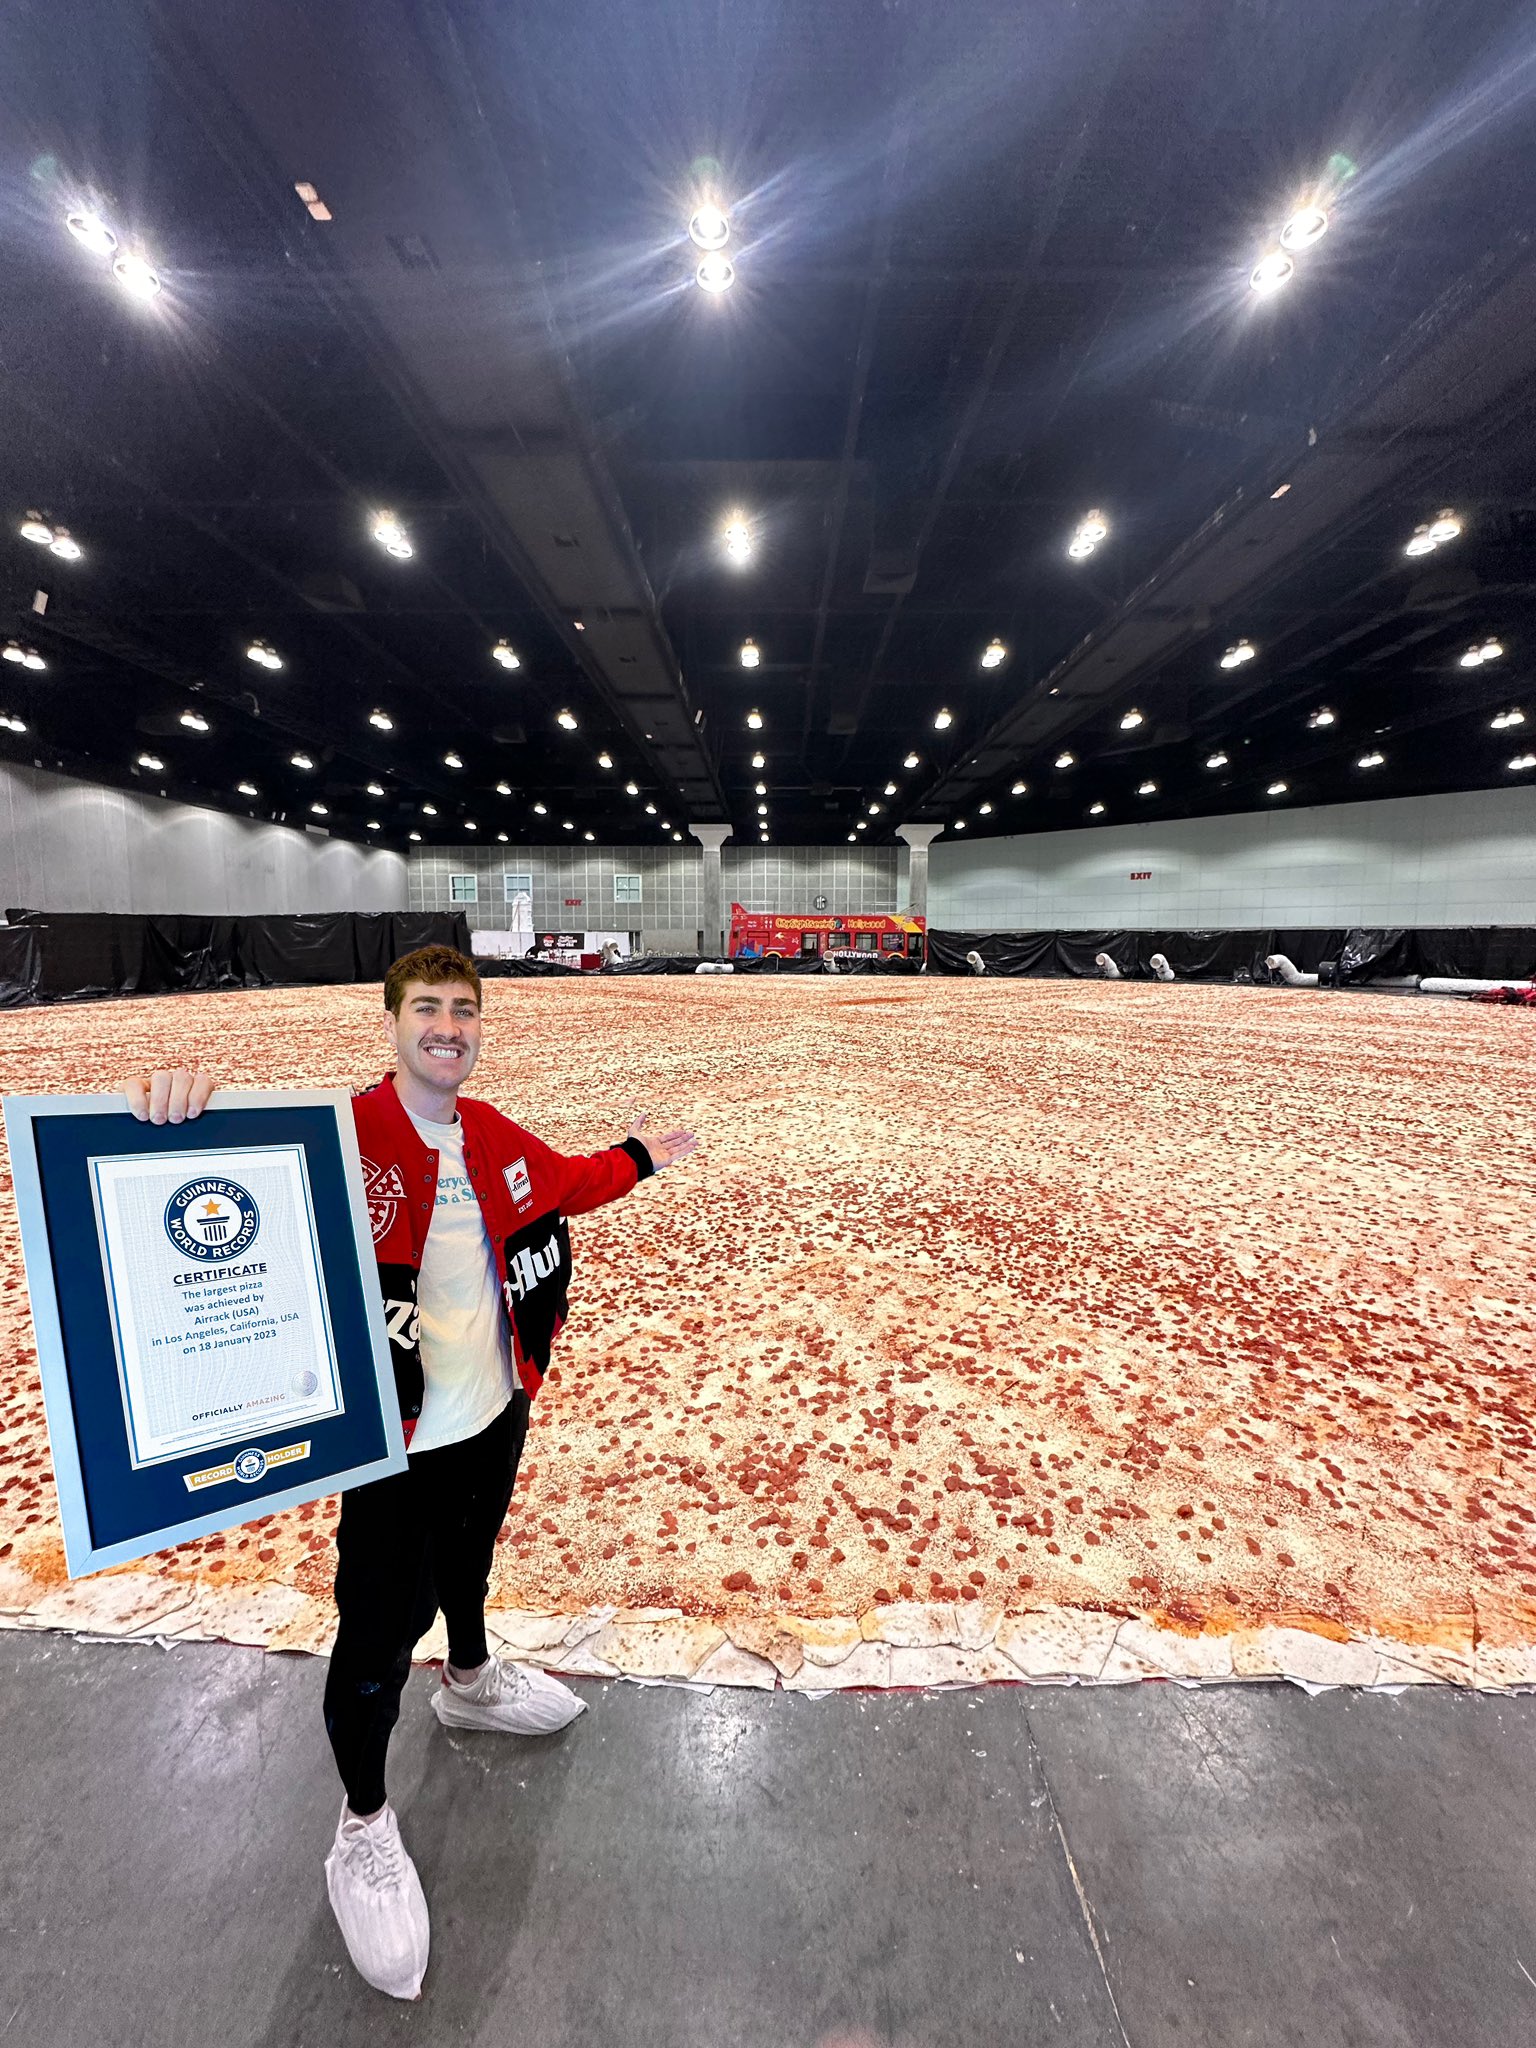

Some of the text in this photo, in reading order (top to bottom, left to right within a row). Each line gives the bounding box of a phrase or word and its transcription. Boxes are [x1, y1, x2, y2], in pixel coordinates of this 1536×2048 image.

[1130, 871, 1152, 880] EXIT
[176, 1181, 245, 1208] GUINNESS
[451, 1193, 461, 1204] a
[170, 1210, 255, 1258] WORLD RECORDS
[173, 1262, 268, 1286] CERTIFICATE
[182, 1281, 263, 1301] The largest pizza
[184, 1293, 265, 1314] was achieved by
[194, 1306, 260, 1326] Airrack (USA)
[151, 1312, 299, 1347] in Los Angeles, California, USA
[182, 1329, 277, 1355] on 18 January 2023
[191, 1393, 286, 1421] OFFICIALLY AMAZING
[266, 1447, 303, 1464] HOLDER
[193, 1466, 233, 1484] RECORD
